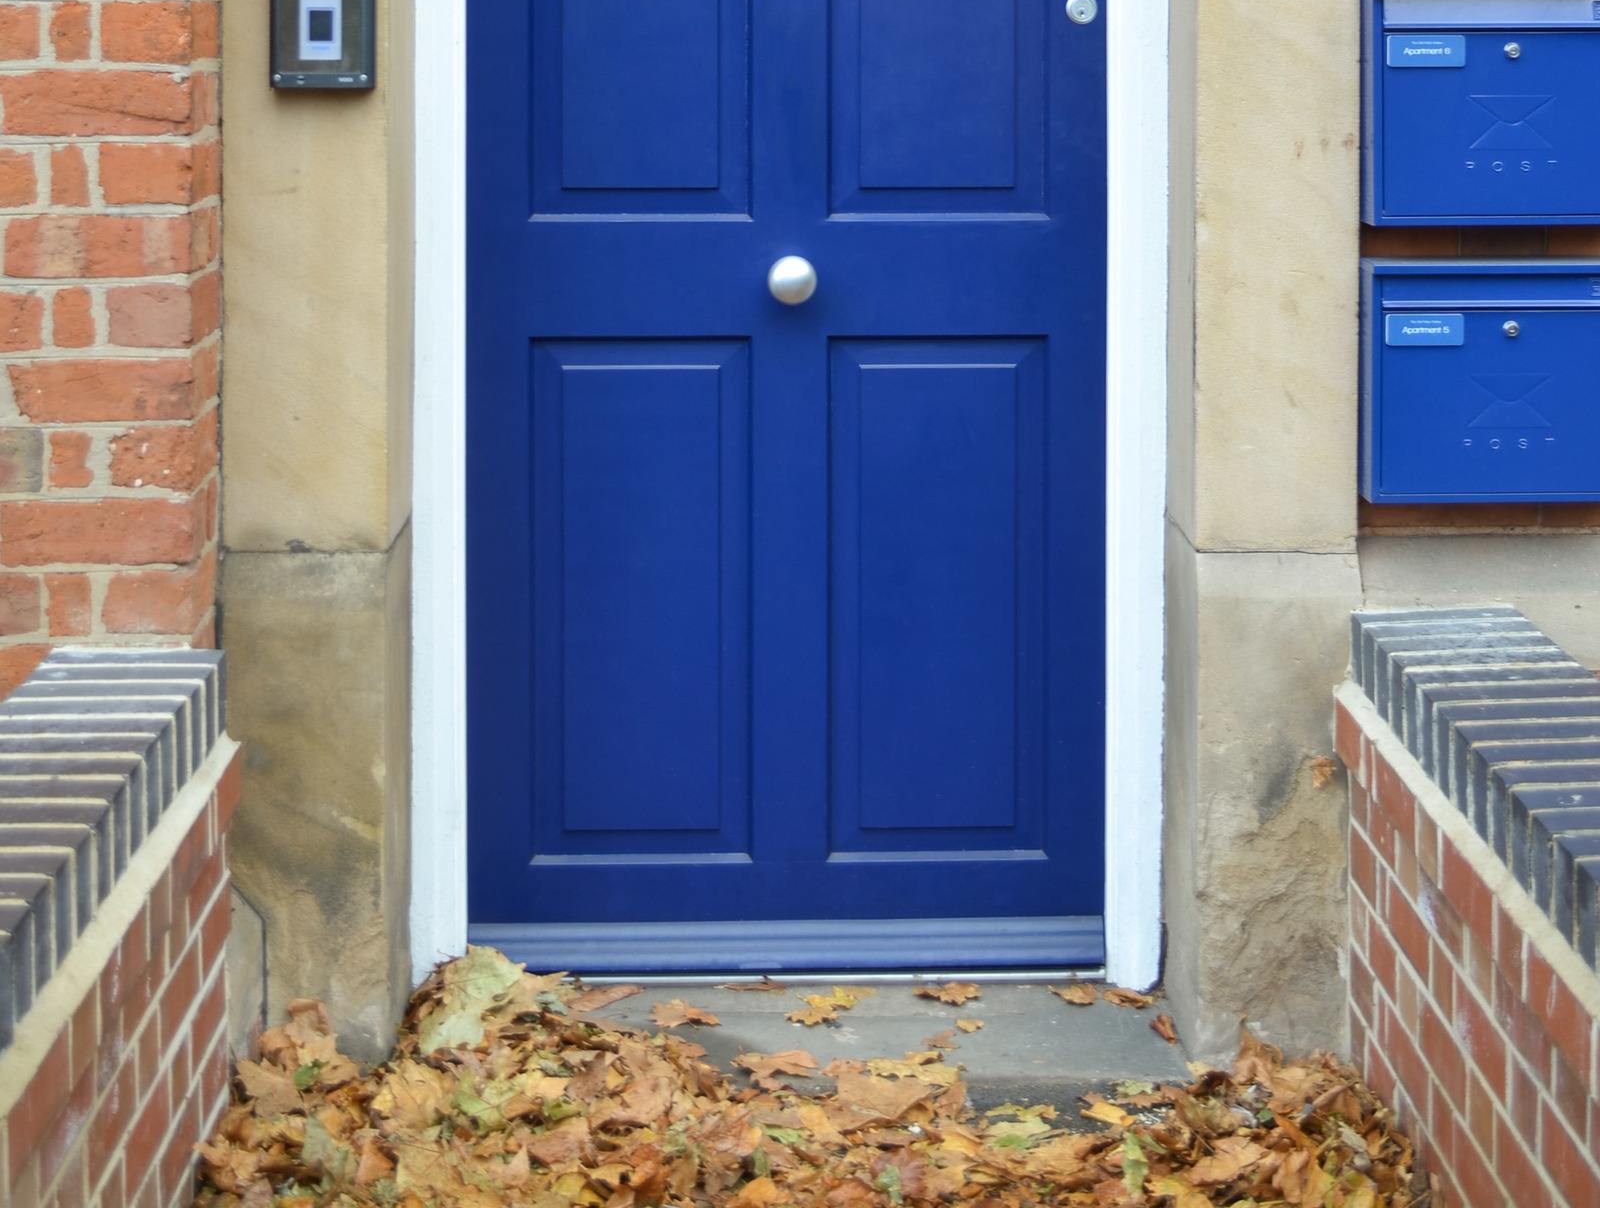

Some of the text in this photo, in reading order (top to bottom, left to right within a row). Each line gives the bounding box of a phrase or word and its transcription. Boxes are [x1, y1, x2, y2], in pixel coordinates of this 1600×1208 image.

[1403, 47, 1443, 56] Apartment
[1402, 326, 1450, 335] Apartment 5
